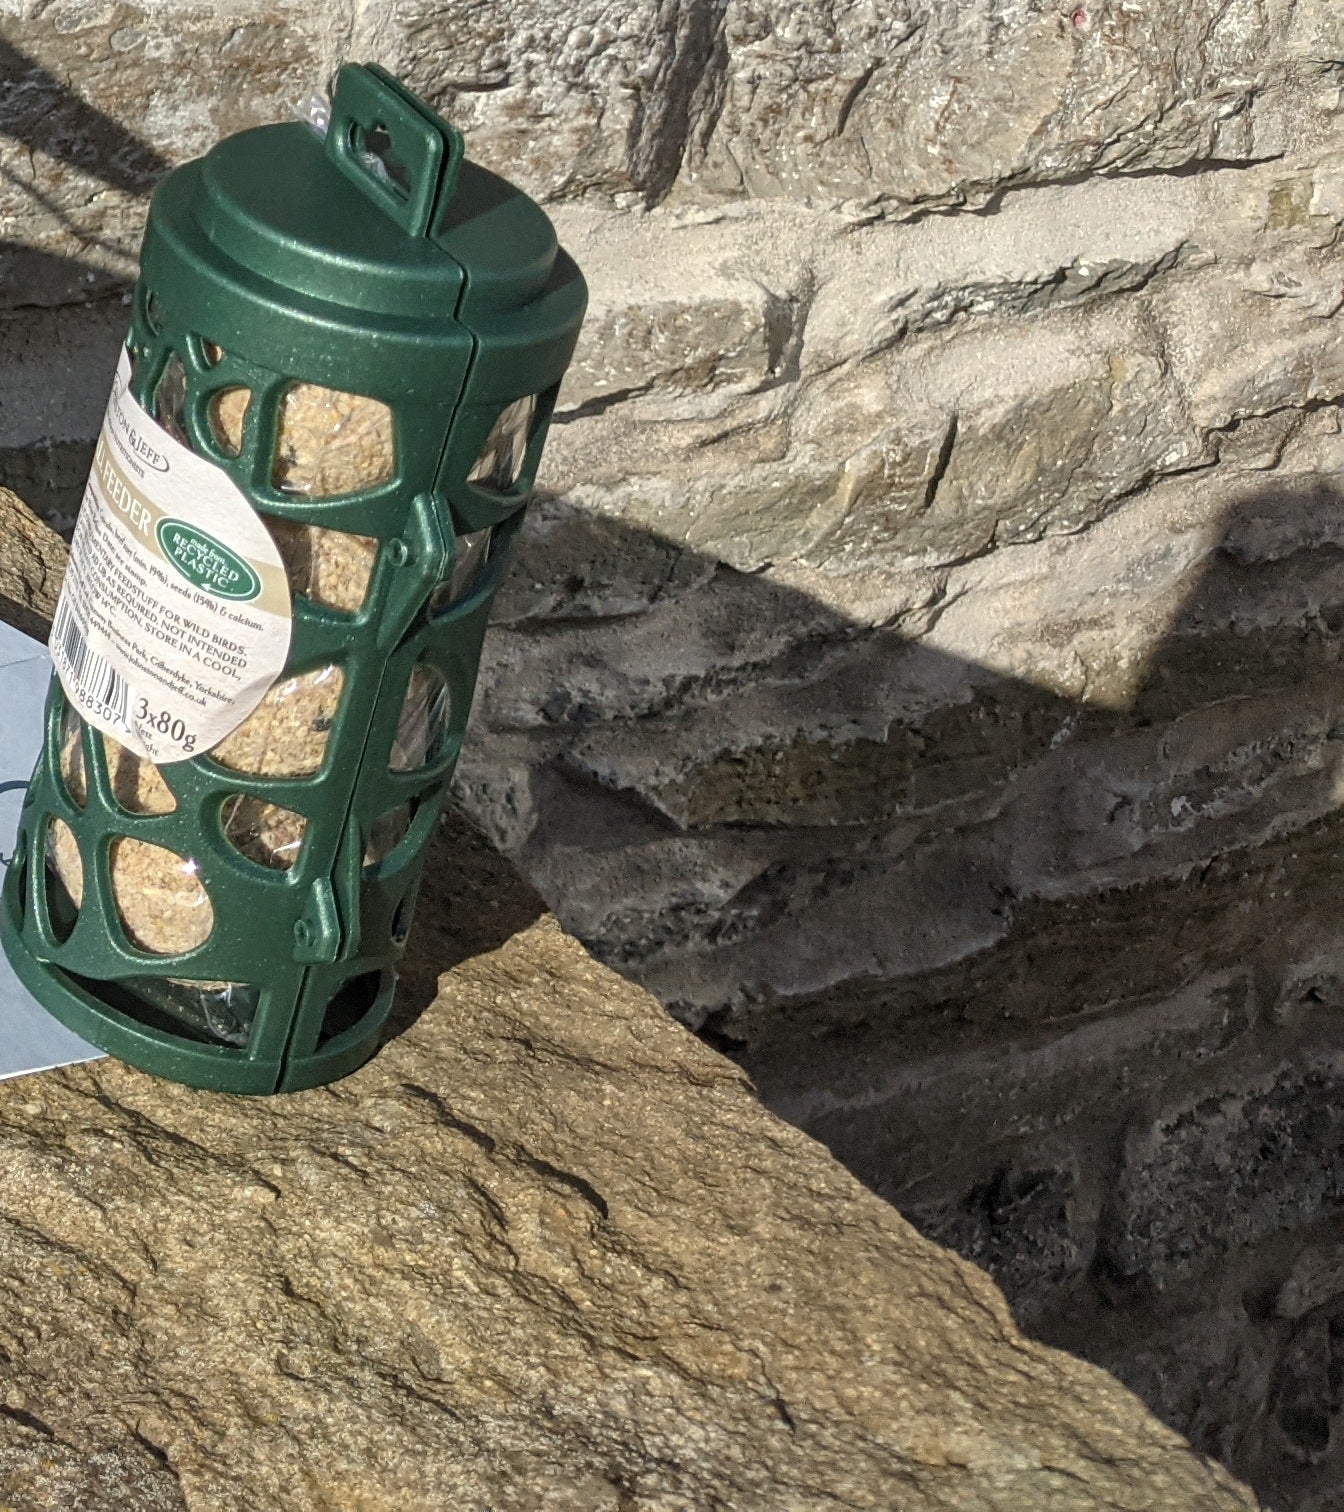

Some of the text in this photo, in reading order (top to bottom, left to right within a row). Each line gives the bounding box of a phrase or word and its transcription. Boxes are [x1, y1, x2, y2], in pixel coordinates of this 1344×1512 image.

[135, 436, 161, 465] JEFF
[102, 460, 152, 537] FEEDER
[173, 532, 239, 582] RECYCLED
[174, 546, 229, 589] PLASTIC
[208, 549, 226, 565] from
[106, 576, 116, 589] AS
[116, 584, 159, 625] REQUIRED.
[160, 619, 187, 639] NOT
[187, 634, 247, 668] INTENDED
[114, 568, 159, 609] FEEDSTUFF
[159, 605, 180, 624] FOR
[183, 618, 210, 638] WILD
[211, 633, 247, 657] BIRDS.
[170, 583, 191, 600] seeds
[193, 592, 218, 613] (15%)
[228, 613, 264, 631] calcium.
[131, 642, 148, 662] Park,
[144, 622, 178, 648] STORE
[178, 642, 193, 657] IN
[192, 651, 201, 662] A
[202, 656, 242, 681] COOL,
[74, 681, 122, 725] 988307
[135, 697, 197, 753] 3x80g
